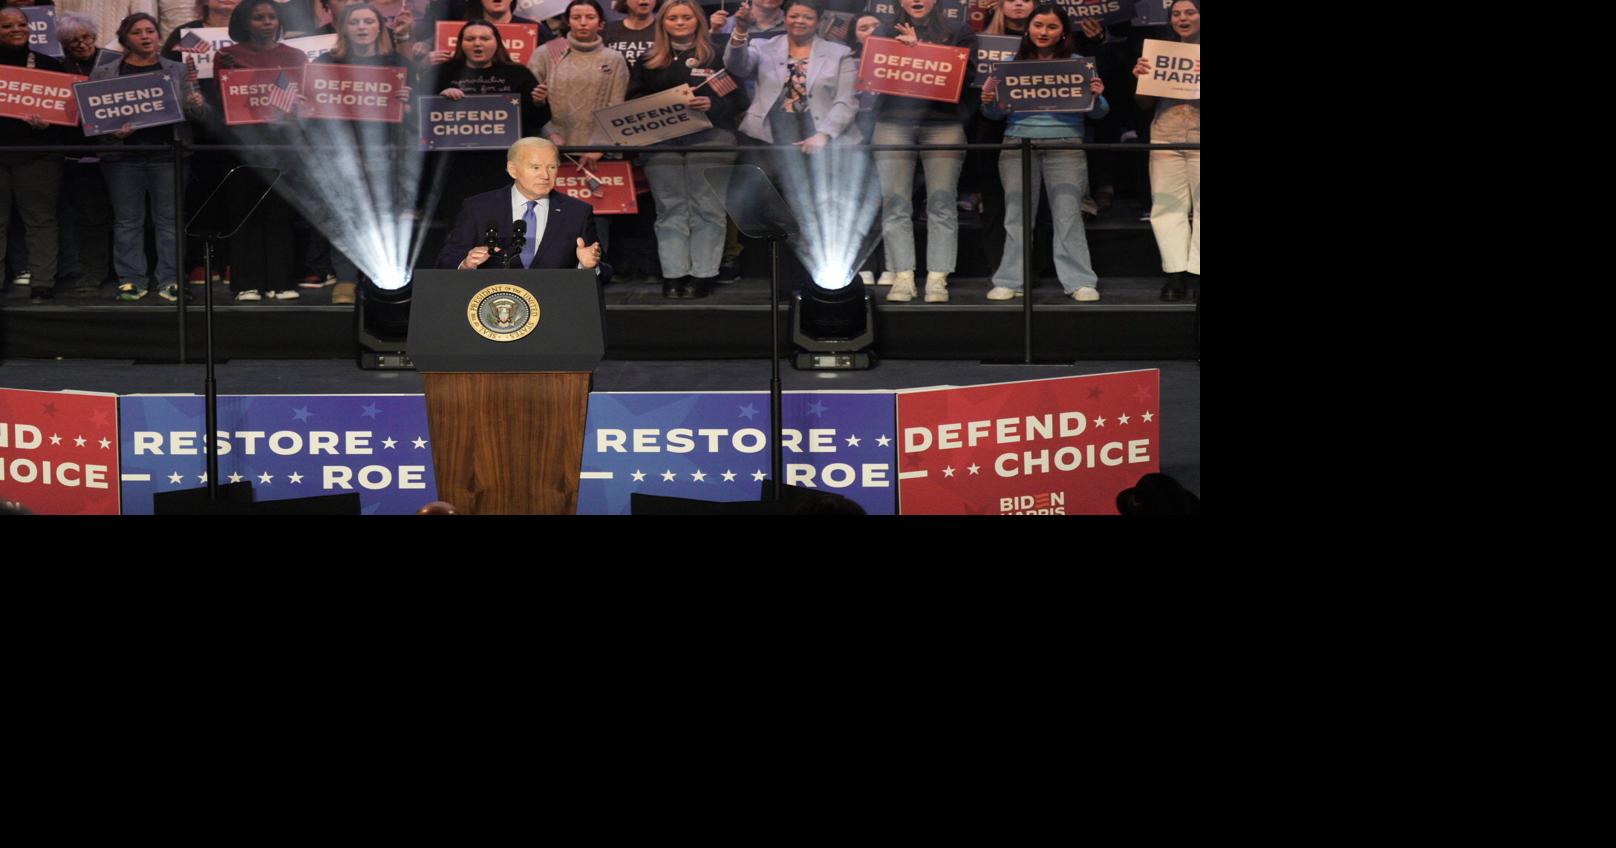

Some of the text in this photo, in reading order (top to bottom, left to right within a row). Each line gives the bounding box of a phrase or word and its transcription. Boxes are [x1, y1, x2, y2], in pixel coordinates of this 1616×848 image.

[1066, 2, 1119, 16] ARRIS
[608, 41, 655, 50] HEALT
[873, 53, 953, 73] DEFEND
[314, 79, 392, 93] DEFEND
[873, 67, 947, 86] CHOICE
[1004, 74, 1084, 86] DEFEND
[88, 87, 164, 107] DEFEND
[315, 93, 388, 107] CHOICE
[1009, 87, 1082, 99] CHOICE
[95, 100, 165, 119] CHOICE
[430, 110, 508, 122] DEFEND
[610, 103, 686, 127] DEFEND
[433, 124, 505, 136] CHOICE
[621, 112, 690, 136] CHOICE
[597, 427, 837, 453] RESTORE
[904, 411, 1087, 454] DEFEND
[133, 430, 373, 456] RESTORE
[994, 438, 1151, 478] CHOICE
[0, 457, 109, 489] OICE
[322, 464, 426, 490] ROE
[786, 463, 890, 488] ROE
[1000, 491, 1065, 512] BIDEN
